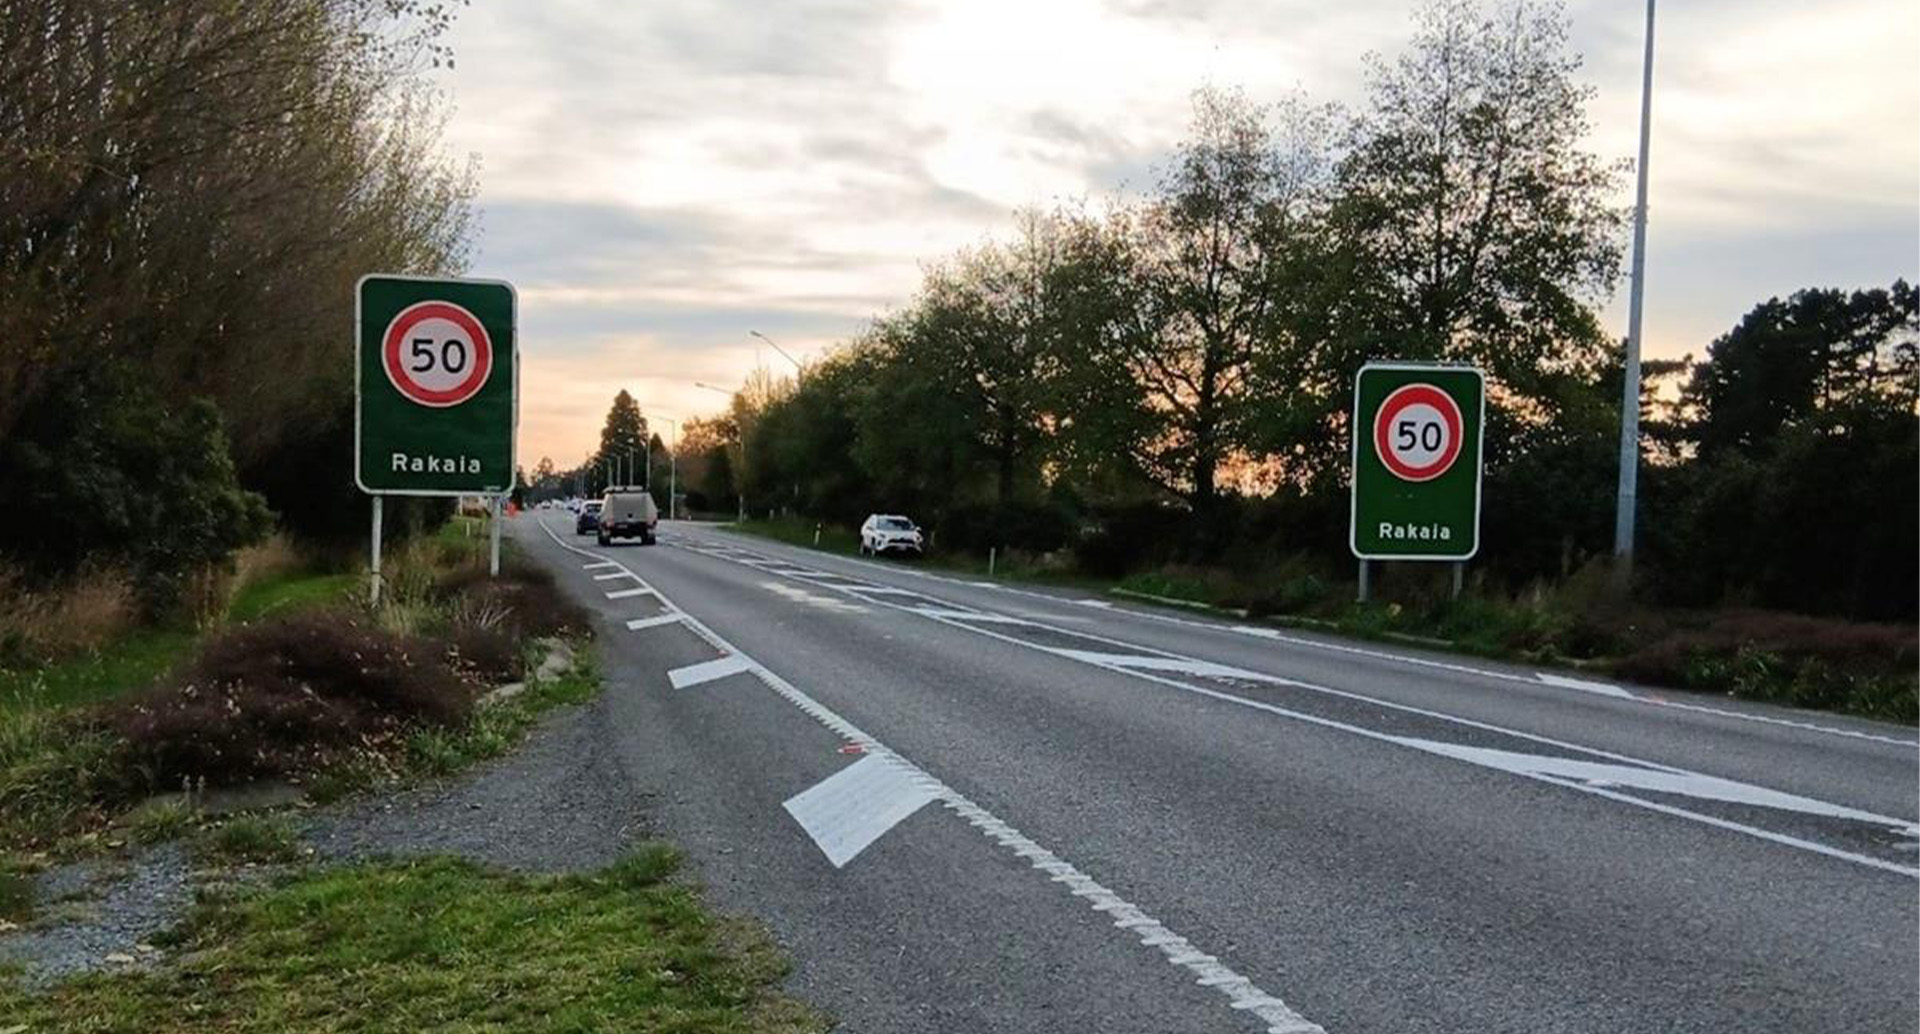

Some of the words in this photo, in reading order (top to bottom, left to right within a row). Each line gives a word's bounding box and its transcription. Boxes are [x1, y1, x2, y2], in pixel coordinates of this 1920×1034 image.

[411, 338, 466, 373] 50
[1397, 421, 1442, 452] 50
[392, 453, 481, 473] Rakaia
[1379, 522, 1450, 540] Rakaia
